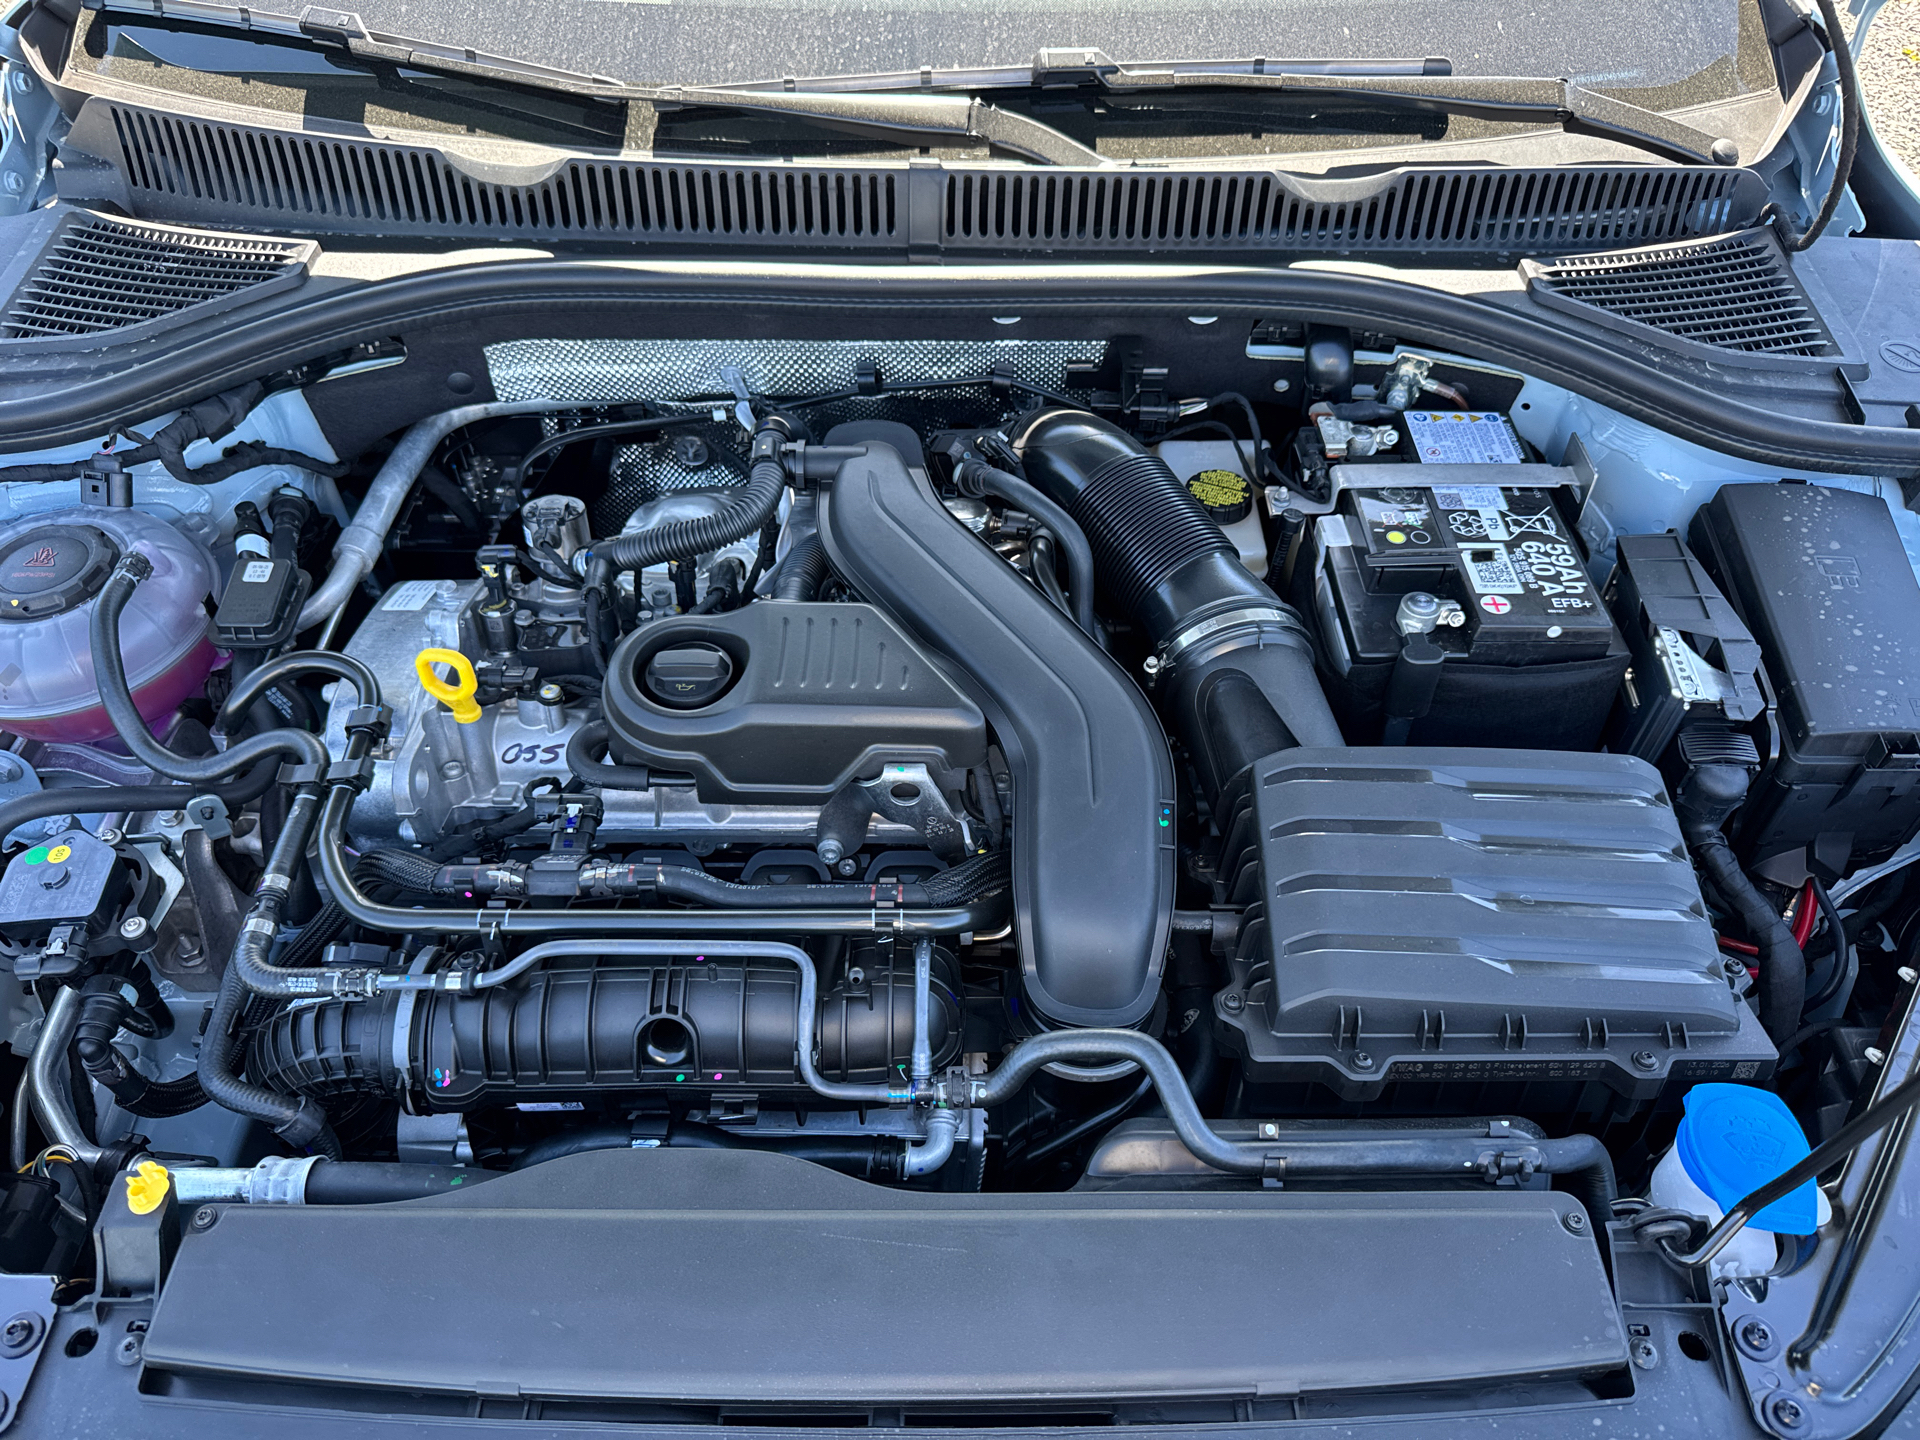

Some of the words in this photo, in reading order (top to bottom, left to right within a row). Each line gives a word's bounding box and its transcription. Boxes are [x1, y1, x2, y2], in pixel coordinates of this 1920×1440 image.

[1485, 517, 1500, 530] Pb
[1521, 541, 1557, 576] 640
[1546, 543, 1588, 594] 59Ah
[1537, 580, 1565, 596] A
[1551, 597, 1593, 608] EFB+
